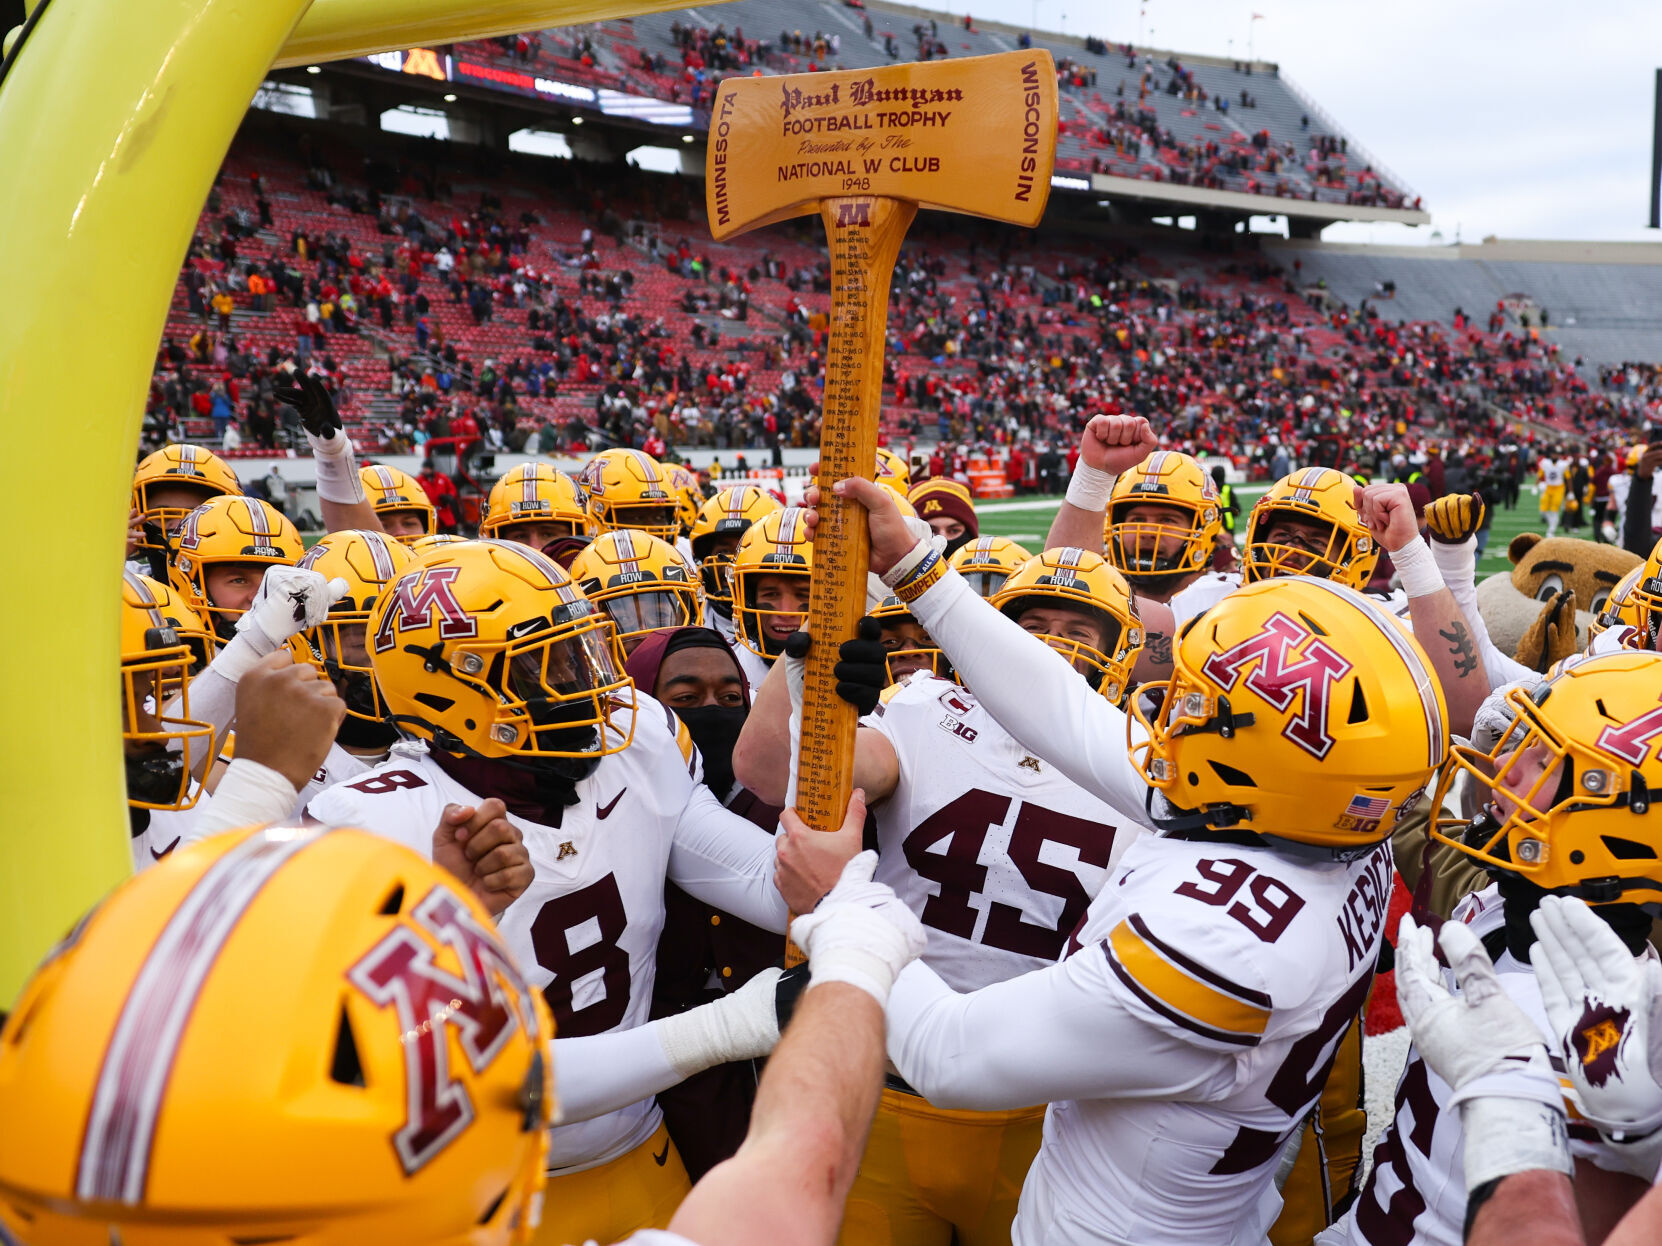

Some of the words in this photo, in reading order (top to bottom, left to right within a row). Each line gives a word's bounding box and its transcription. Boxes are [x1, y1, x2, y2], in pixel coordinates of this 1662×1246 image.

[780, 80, 840, 120] Paul
[849, 77, 964, 110] Bunyan
[783, 114, 873, 136] FOOTBALL
[880, 111, 952, 128] TROPHY
[1015, 60, 1041, 202] WISCONSIN
[797, 139, 854, 155] Presented
[856, 137, 874, 156] by
[879, 134, 914, 150] The
[716, 92, 738, 225] MINNESOTA
[778, 159, 856, 181] NATIONAL
[862, 158, 882, 173] W
[889, 156, 940, 172] CLUB
[841, 177, 871, 190] 1948
[835, 203, 871, 228] M
[1140, 482, 1159, 492] ROW
[522, 500, 541, 510] ROW
[922, 500, 944, 514] M
[725, 519, 742, 528] ROW
[772, 553, 794, 564] ROW
[970, 554, 991, 564] ROW
[620, 572, 643, 584] ROW
[898, 568, 941, 600] COMPETE
[1049, 576, 1076, 588] ROW
[374, 567, 478, 654] M
[566, 600, 589, 615] ROW
[1201, 611, 1354, 762] M
[1018, 756, 1041, 774] M
[344, 769, 429, 795] 8
[556, 840, 579, 861] M
[902, 788, 1117, 961] 45
[1173, 858, 1306, 944] 99
[1336, 841, 1394, 973] KESICH
[530, 871, 632, 1038] 8
[347, 885, 534, 1176] M
[1582, 1018, 1622, 1066] M
